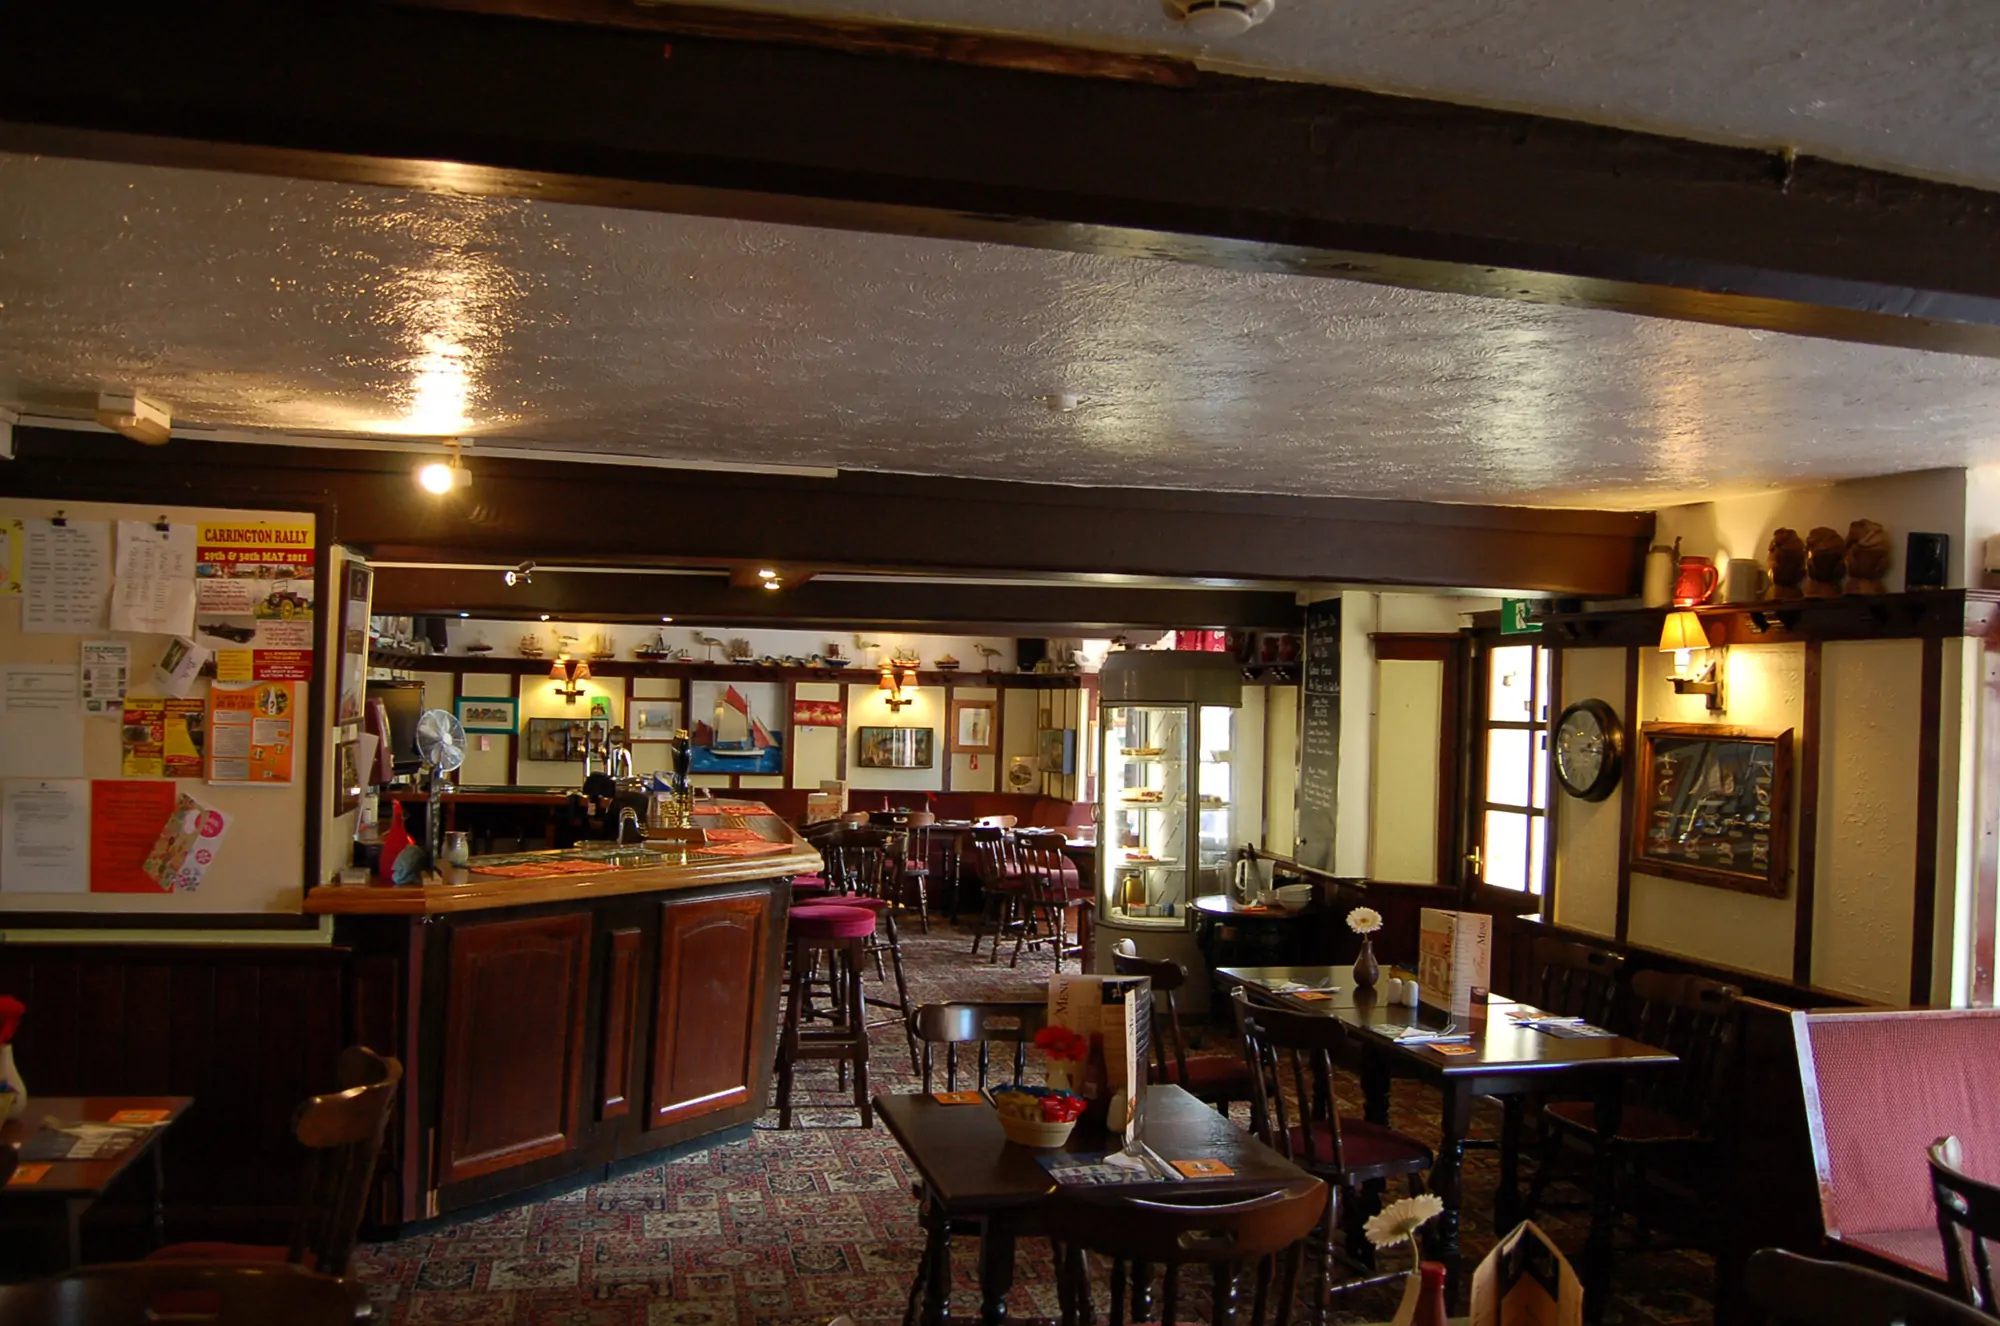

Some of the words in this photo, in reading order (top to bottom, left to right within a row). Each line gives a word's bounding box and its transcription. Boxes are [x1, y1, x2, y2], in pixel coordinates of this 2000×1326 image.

[205, 528, 272, 543] CARRINGTON
[275, 529, 309, 544] RALLY
[204, 551, 224, 561] 29th
[227, 552, 237, 562] &
[239, 552, 261, 562] 30th
[262, 552, 285, 562] MAY
[287, 553, 308, 562] 2011
[1056, 979, 1069, 1015] MENU
